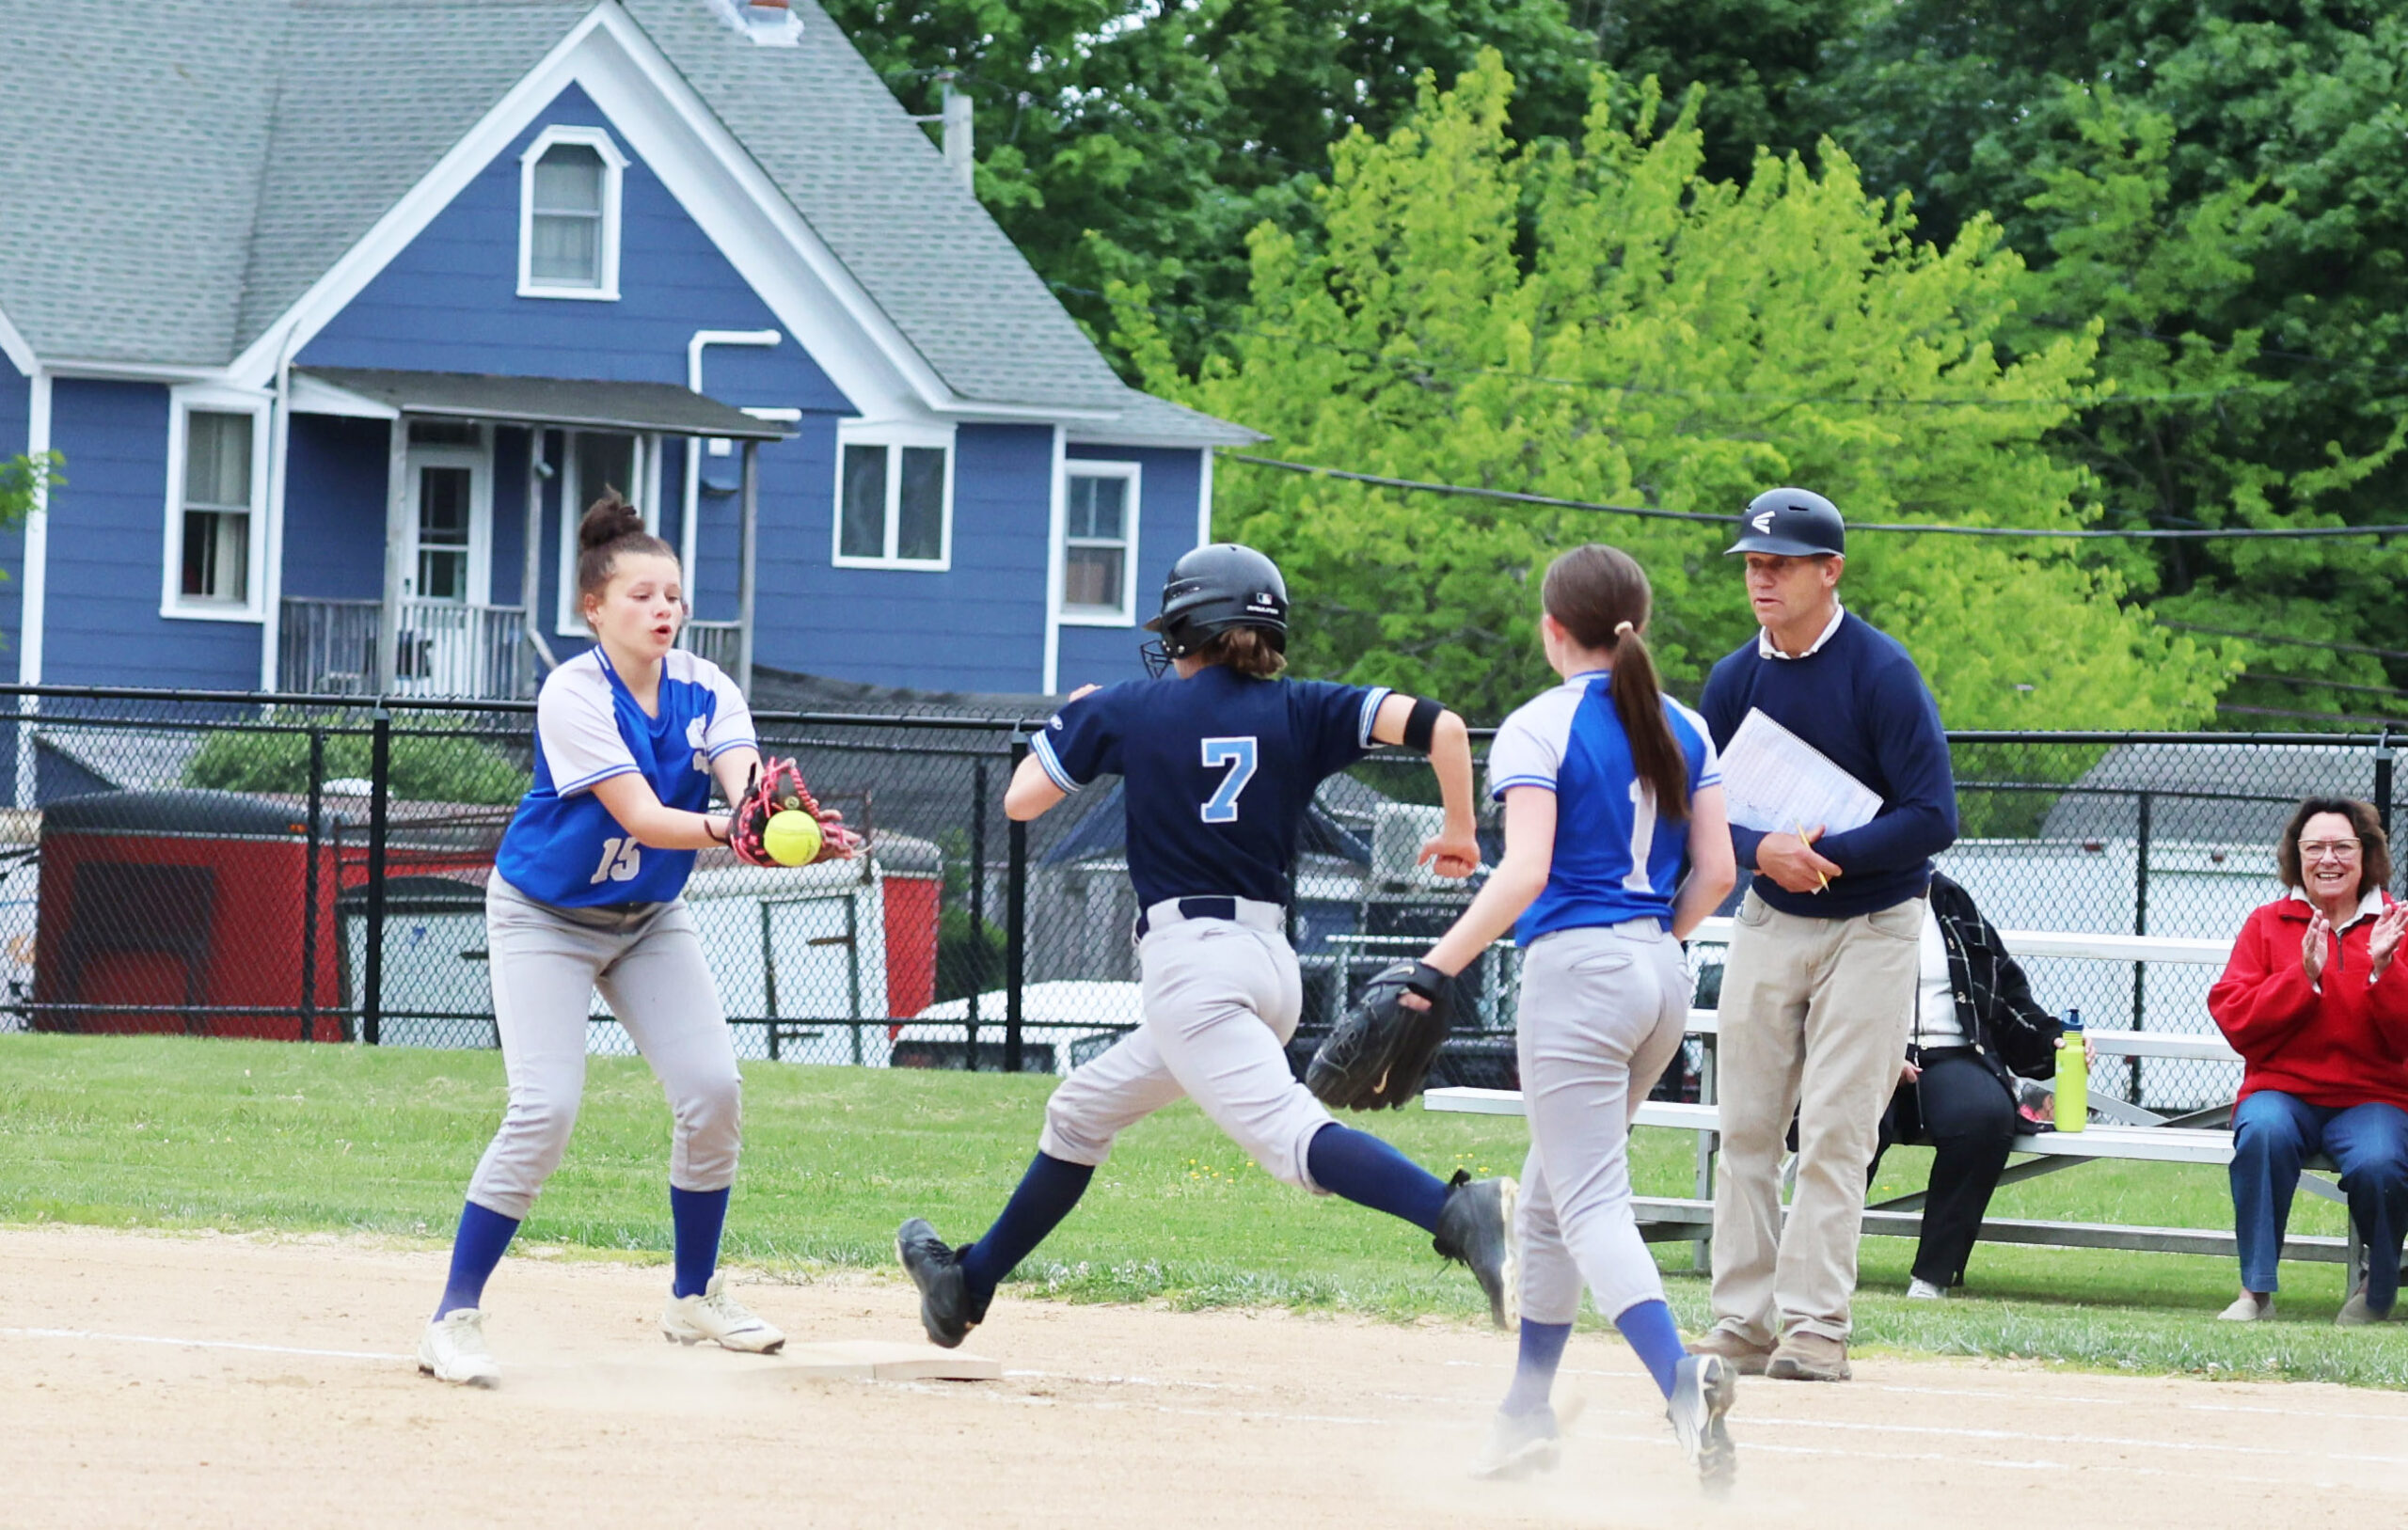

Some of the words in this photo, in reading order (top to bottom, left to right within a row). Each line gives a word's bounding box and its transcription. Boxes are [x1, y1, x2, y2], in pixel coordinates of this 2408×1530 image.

[1201, 735, 1258, 823] 7
[590, 836, 641, 884] 15
[1622, 775, 1657, 894] 1
